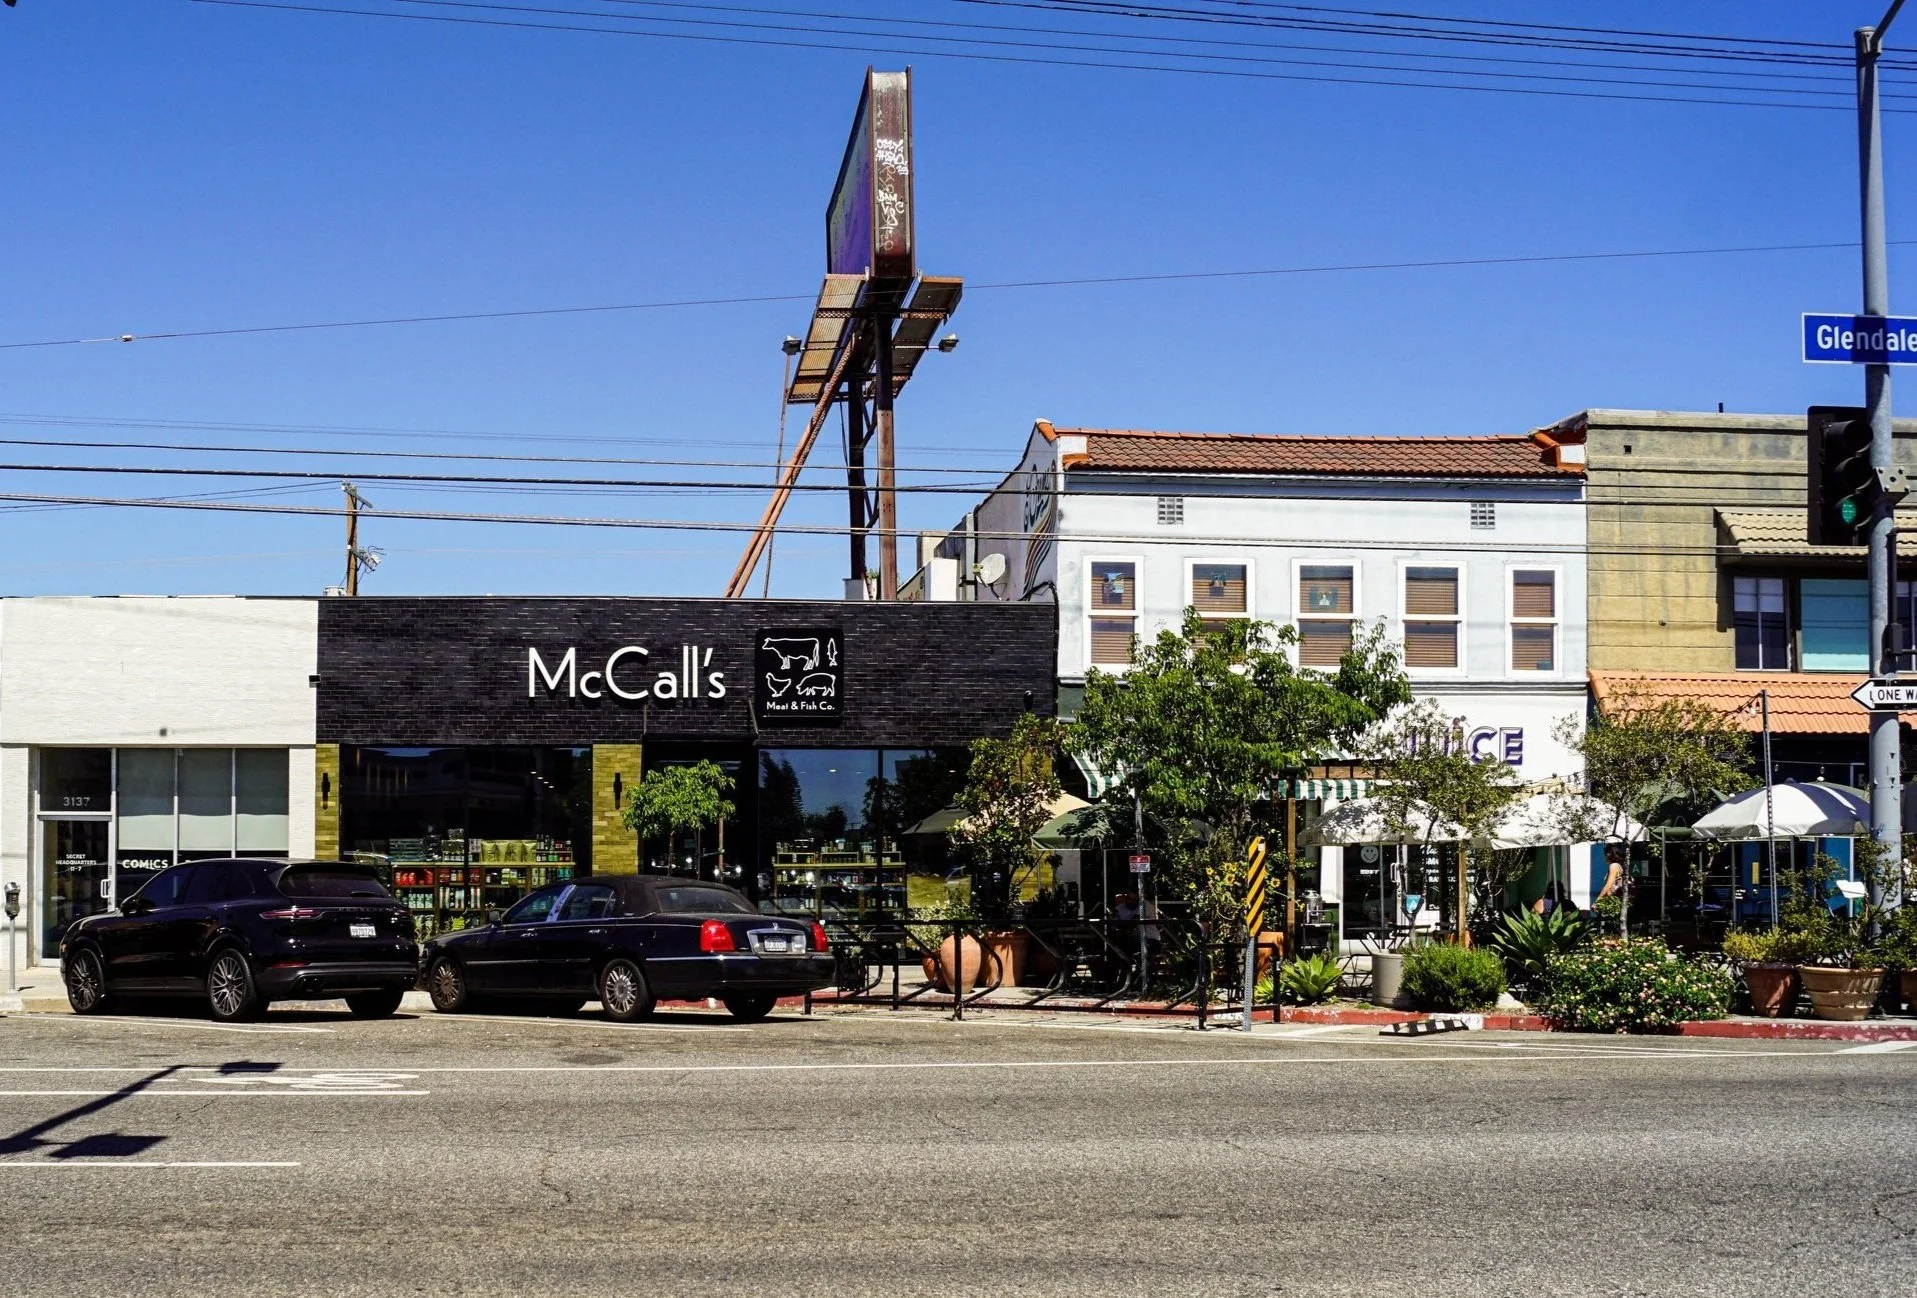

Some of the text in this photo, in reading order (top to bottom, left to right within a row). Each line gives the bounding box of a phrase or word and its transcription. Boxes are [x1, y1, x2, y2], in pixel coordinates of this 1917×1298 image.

[1817, 324, 1917, 352] Glendale
[528, 645, 726, 700] McCall's
[1877, 689, 1901, 701] ONE
[766, 701, 835, 710] Meat & Fish Co.
[63, 796, 90, 807] 3137
[122, 859, 168, 869] COMICS
